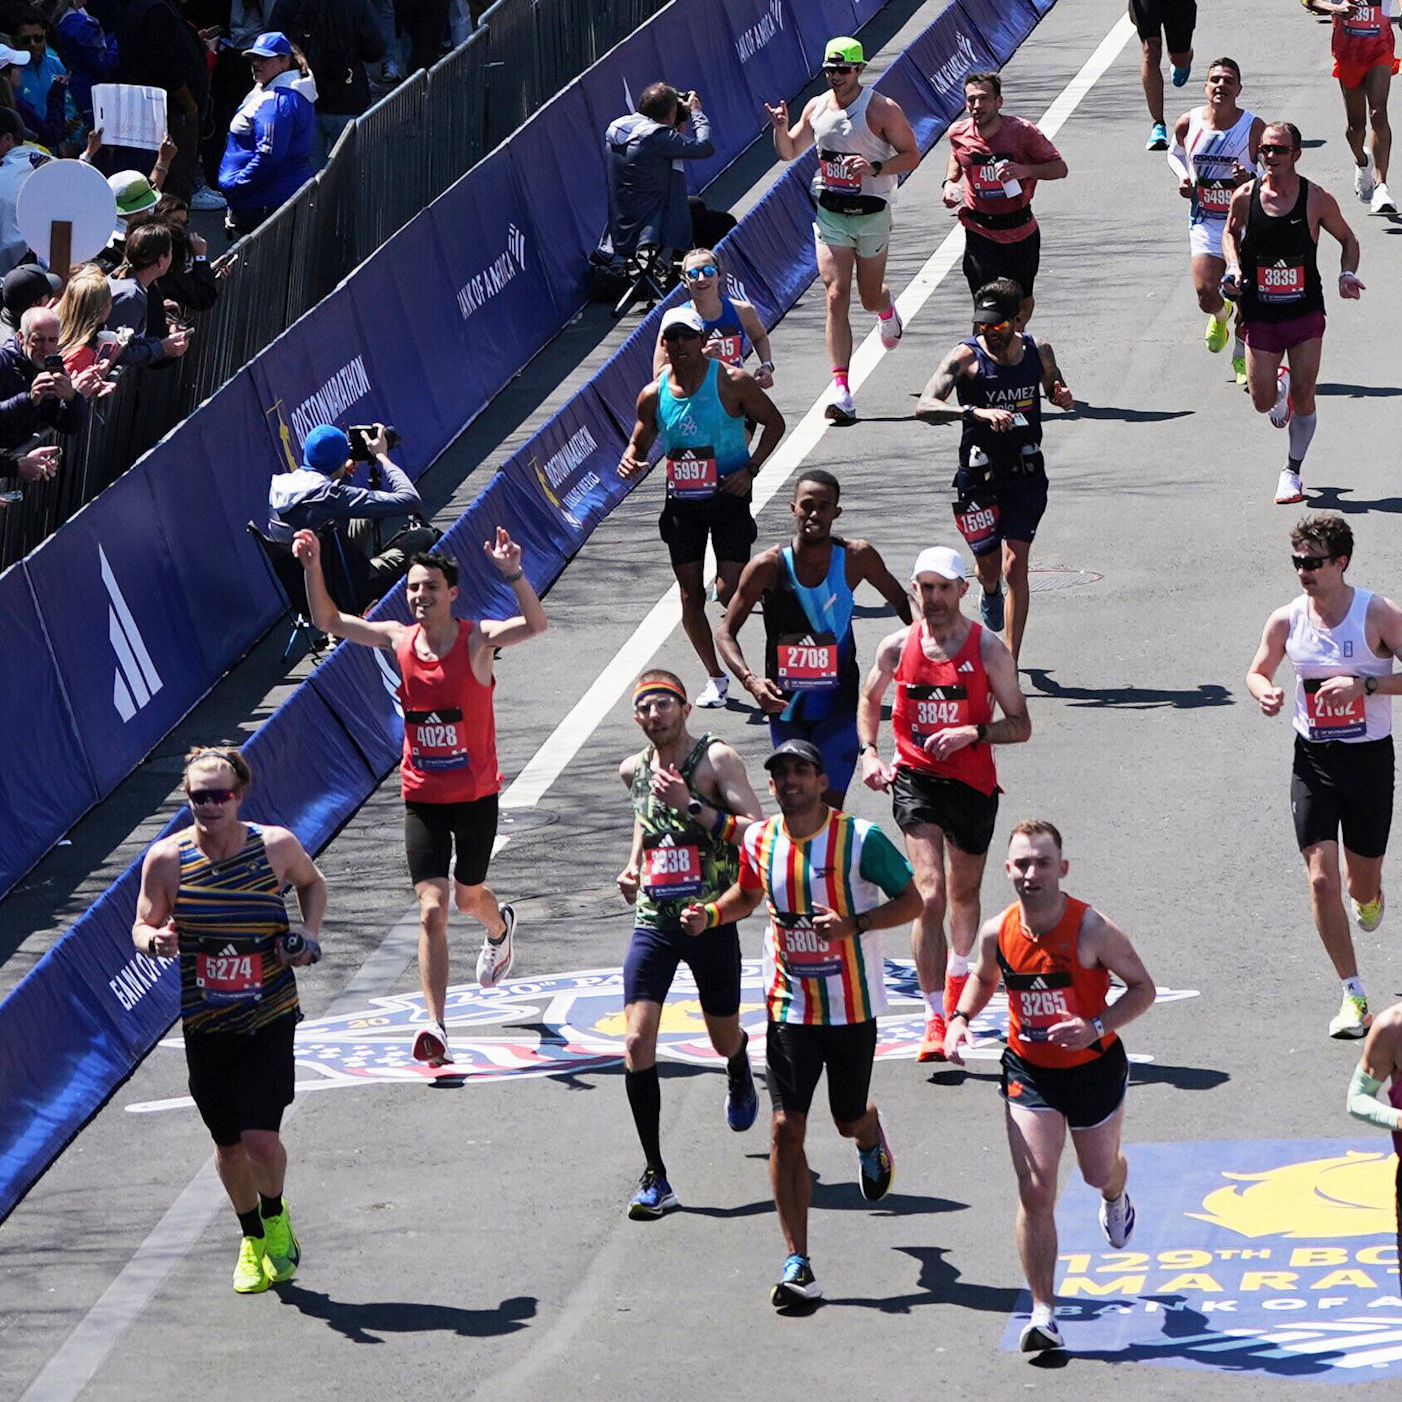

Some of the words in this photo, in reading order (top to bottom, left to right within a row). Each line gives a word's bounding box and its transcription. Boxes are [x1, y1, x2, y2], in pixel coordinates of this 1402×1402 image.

[1203, 189, 1233, 204] 5499
[1264, 268, 1298, 285] 3839
[985, 385, 1035, 402] YAMEZ
[673, 461, 708, 480] 5997
[962, 508, 995, 533] 1599
[788, 648, 829, 668] 2708
[917, 701, 959, 723] 3842
[417, 725, 458, 747] 4028
[206, 955, 251, 980] 5274
[1020, 993, 1067, 1016] 3265
[346, 1016, 390, 1028] 20
[1058, 1249, 1271, 1273] 129TH
[1055, 1299, 1238, 1316] BANK
[1261, 1298, 1348, 1311] OF
